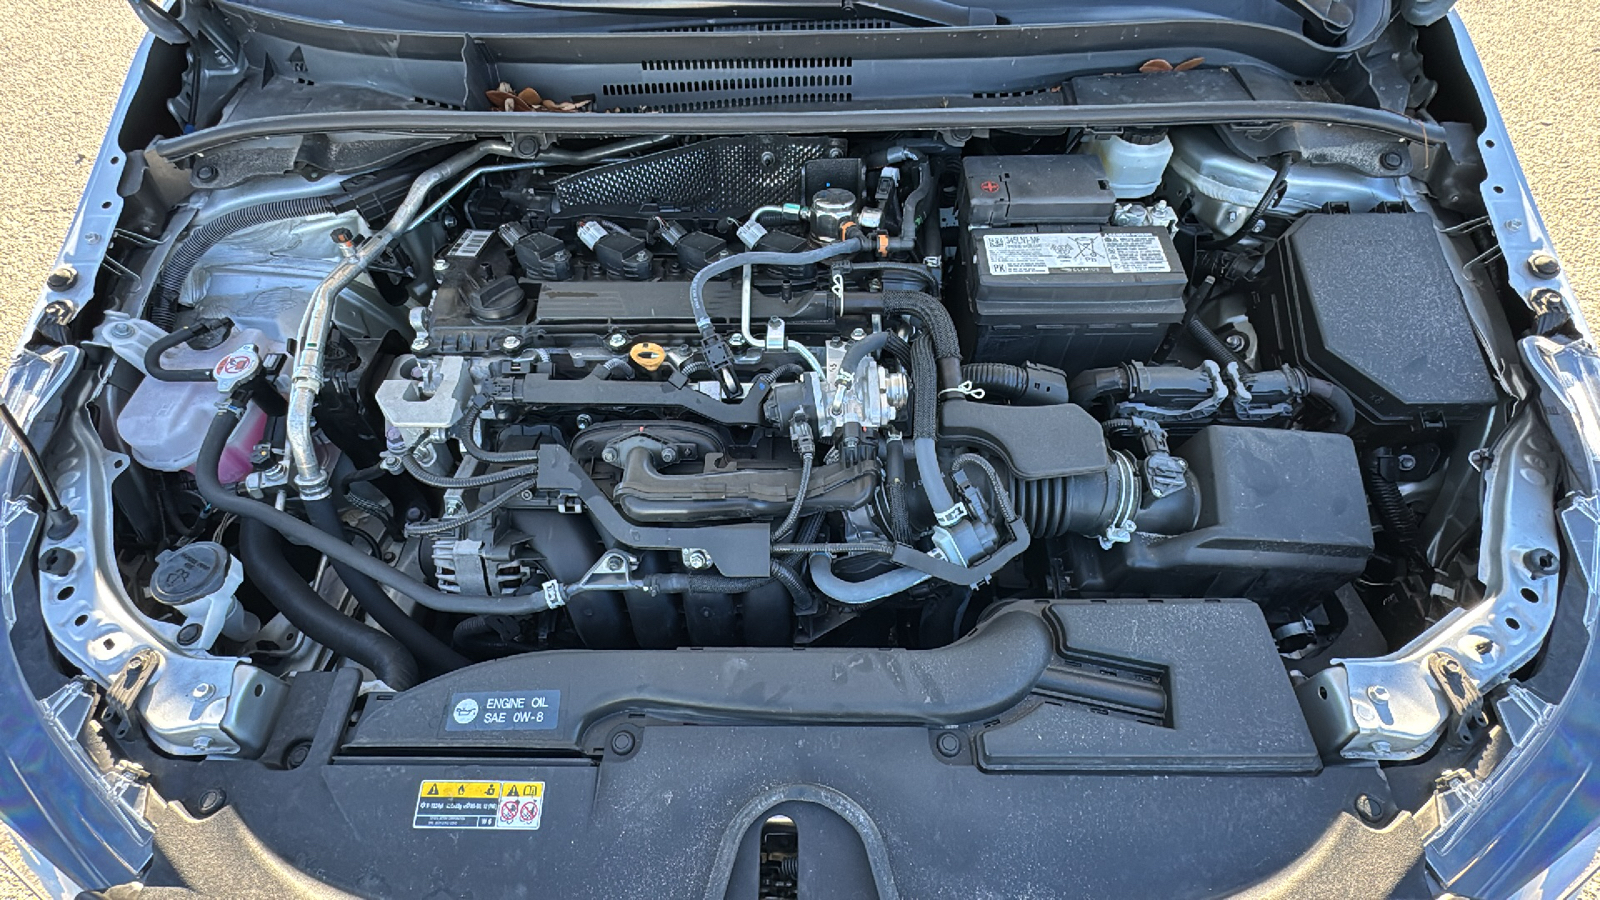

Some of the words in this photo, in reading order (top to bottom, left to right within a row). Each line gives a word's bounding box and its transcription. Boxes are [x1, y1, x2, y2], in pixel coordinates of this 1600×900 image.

[993, 264, 1006, 273] PK
[486, 698, 525, 709] ENGINE
[531, 697, 549, 708] OIL
[483, 712, 507, 724] SAE
[512, 711, 544, 723] 0W-8
